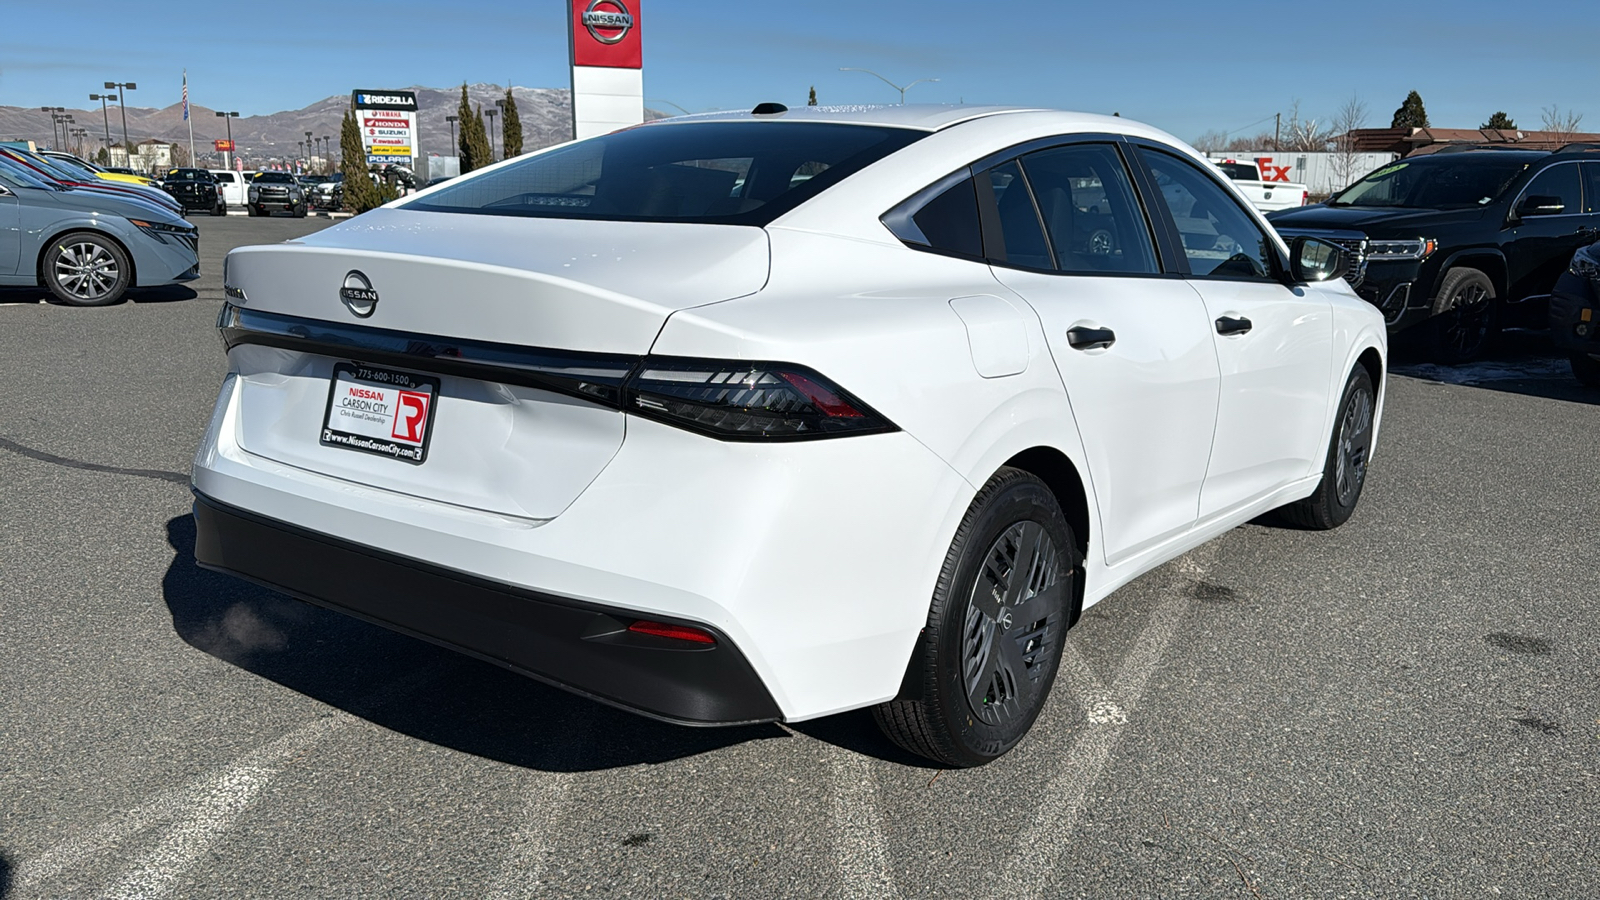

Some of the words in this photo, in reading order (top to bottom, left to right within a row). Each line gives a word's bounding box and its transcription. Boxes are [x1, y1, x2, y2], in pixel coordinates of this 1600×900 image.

[588, 14, 630, 25] NISSAN
[372, 95, 414, 105] RIDEZILLA
[358, 369, 409, 385] 775-600-1500
[349, 387, 384, 401] NISSAN
[342, 397, 371, 411] CARSON
[372, 403, 389, 413] CITY
[340, 409, 351, 418] Chris
[351, 411, 365, 420] Russell
[364, 413, 386, 425] Dealership
[331, 435, 414, 457] www.NissanCarsonCity.com
